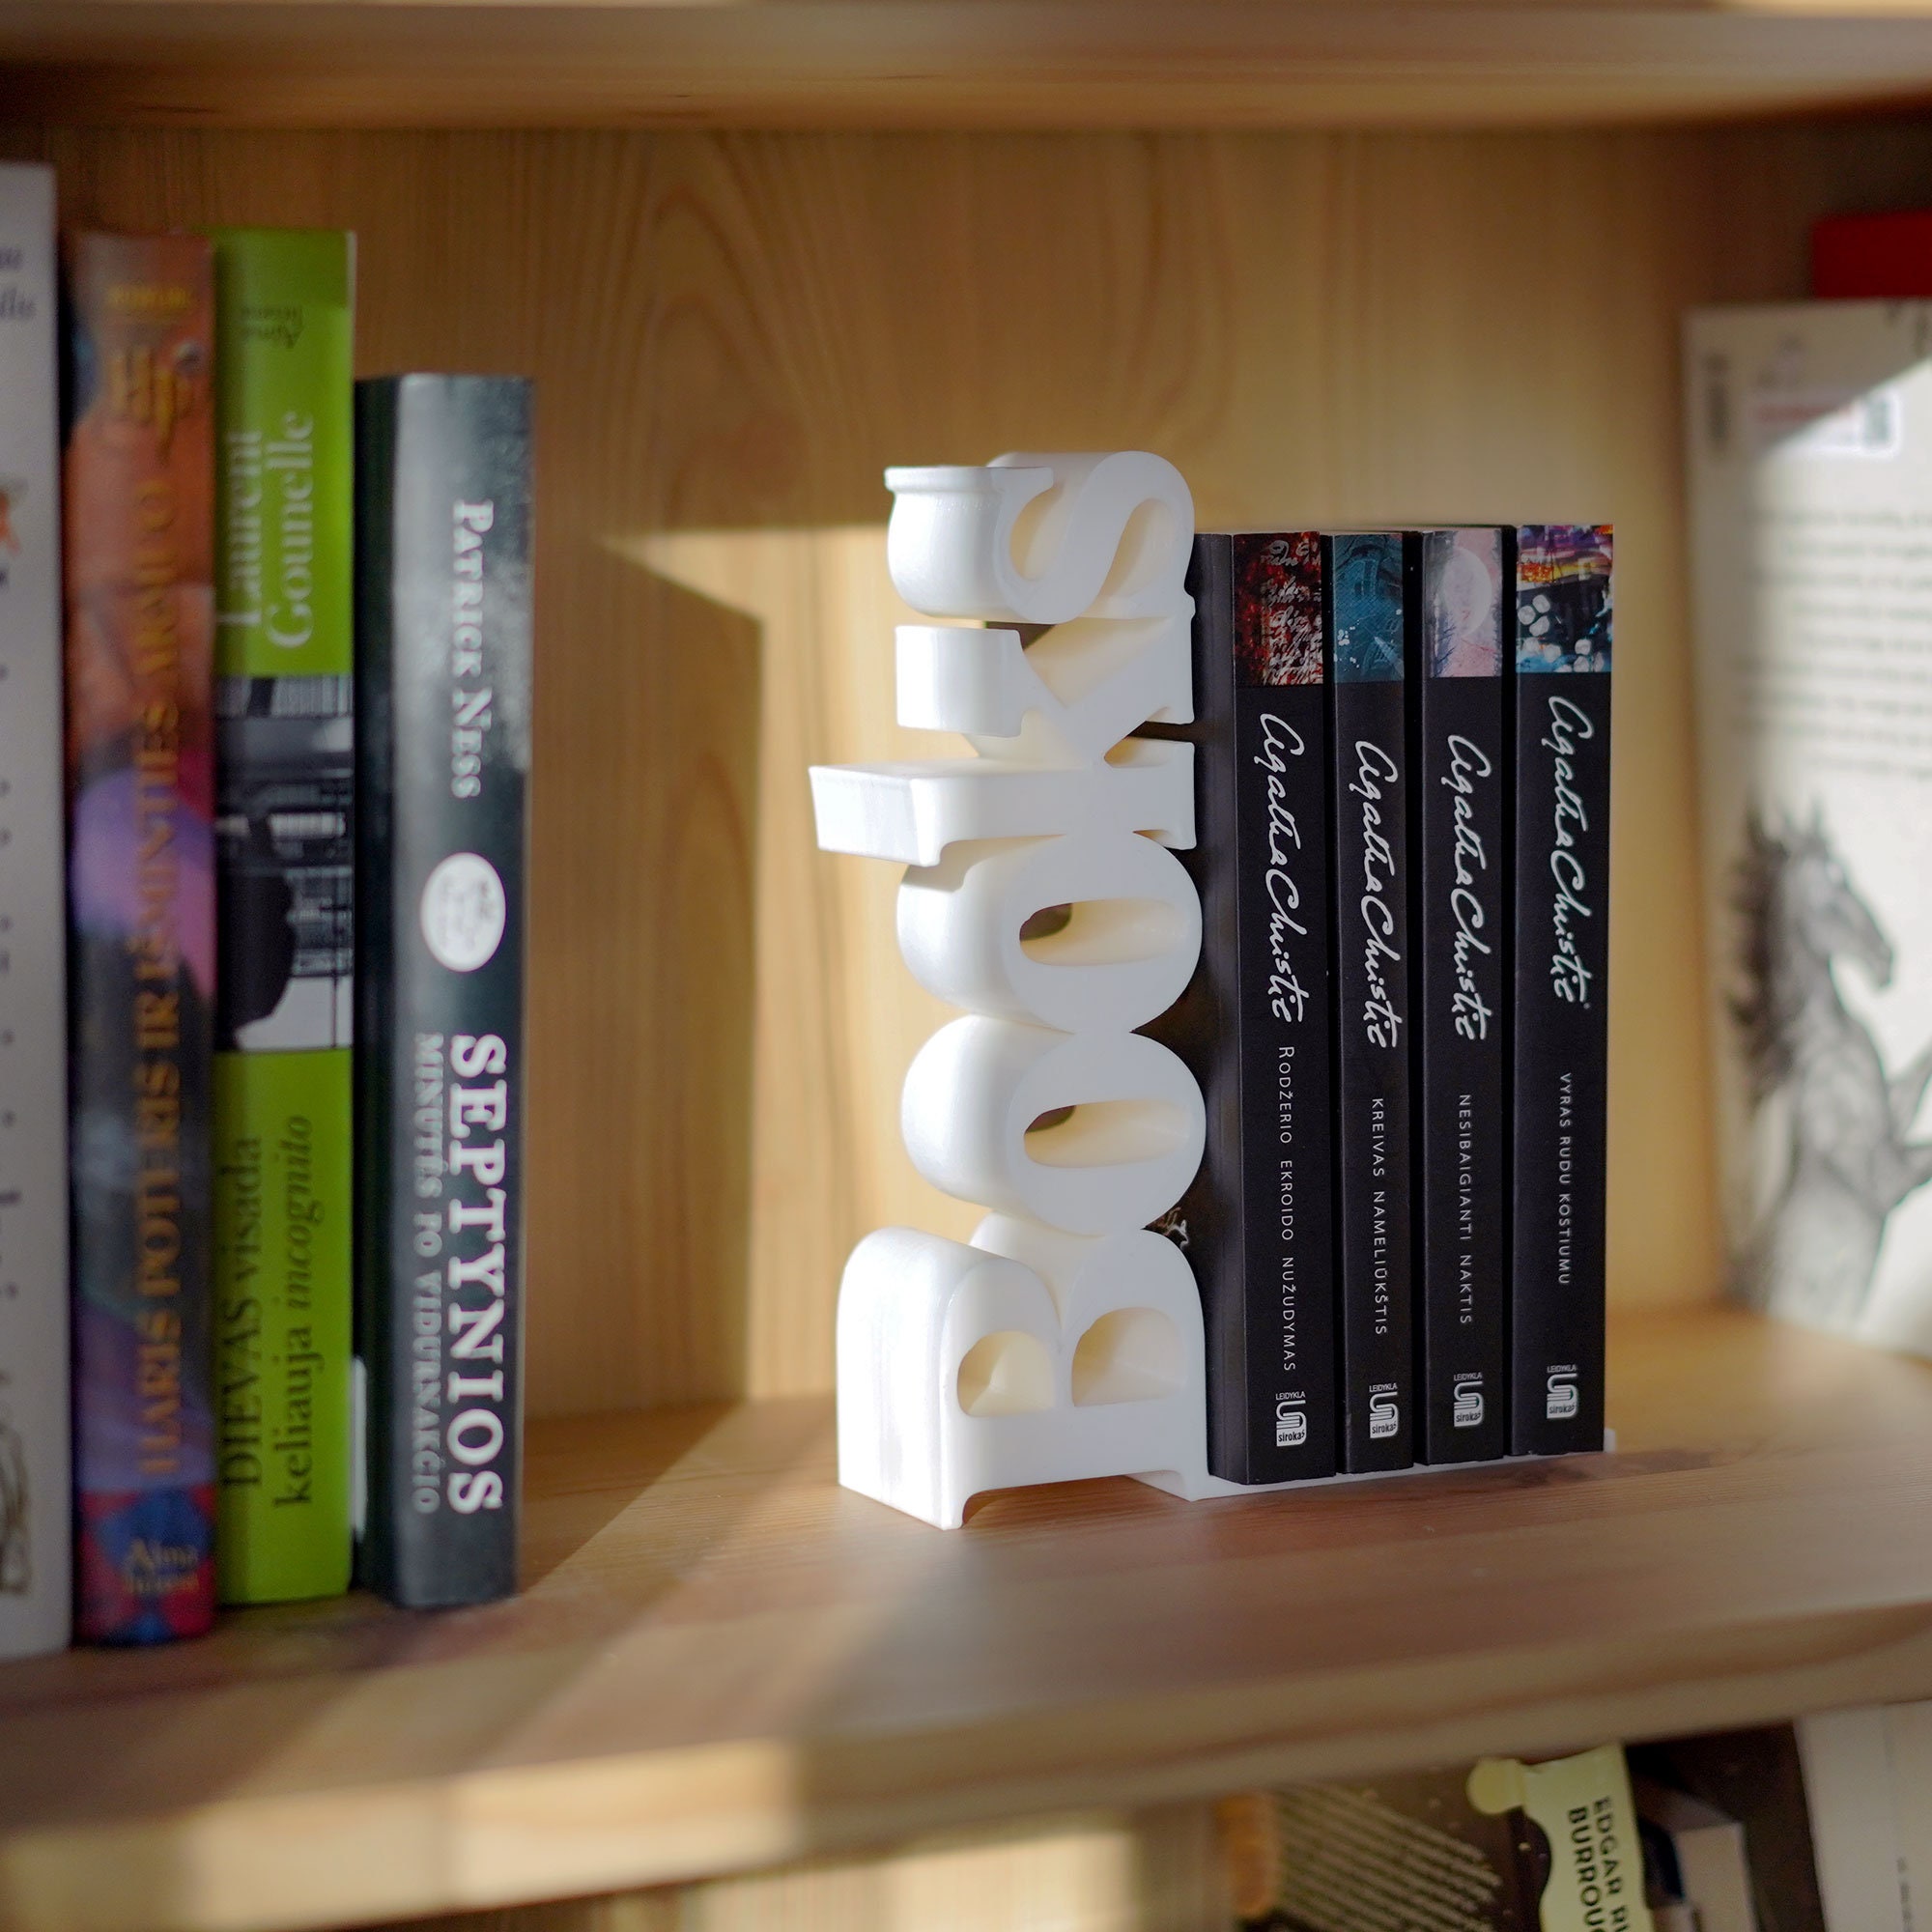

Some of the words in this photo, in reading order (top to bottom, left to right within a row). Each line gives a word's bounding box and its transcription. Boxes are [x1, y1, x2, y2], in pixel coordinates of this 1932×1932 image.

[217, 430, 263, 628] Laurent
[264, 412, 314, 648] Gounelle
[809, 450, 1208, 1530] Books
[1278, 1046, 1295, 1144] RODŽERIO
[1372, 1097, 1385, 1177] KREIVAS
[1559, 1072, 1572, 1127] VYRAS
[220, 1138, 263, 1280] visada
[1280, 1160, 1293, 1240] EKROIDO
[1459, 1094, 1471, 1239] NESIBAIGIANTI
[1559, 1136, 1571, 1183] RUDU
[272, 1116, 325, 1312] incognito
[413, 1211, 443, 1258] PO
[1373, 1191, 1389, 1335] NAMELIŪKŠTIS
[1558, 1193, 1570, 1284] KOSTIUMU
[447, 1034, 507, 1515] SEPTYNIOS
[1282, 1257, 1296, 1371] NUŽUDYMAS
[1460, 1255, 1471, 1323] NAKTIS
[220, 1298, 263, 1489] DIEVAS
[272, 1327, 325, 1509] keliauja
[1275, 1391, 1306, 1401] LEIDYKLA
[1369, 1383, 1398, 1393] LEIDYKLA
[1453, 1372, 1483, 1381] LEIDYKLA
[1593, 1796, 1622, 1895] EDGAR
